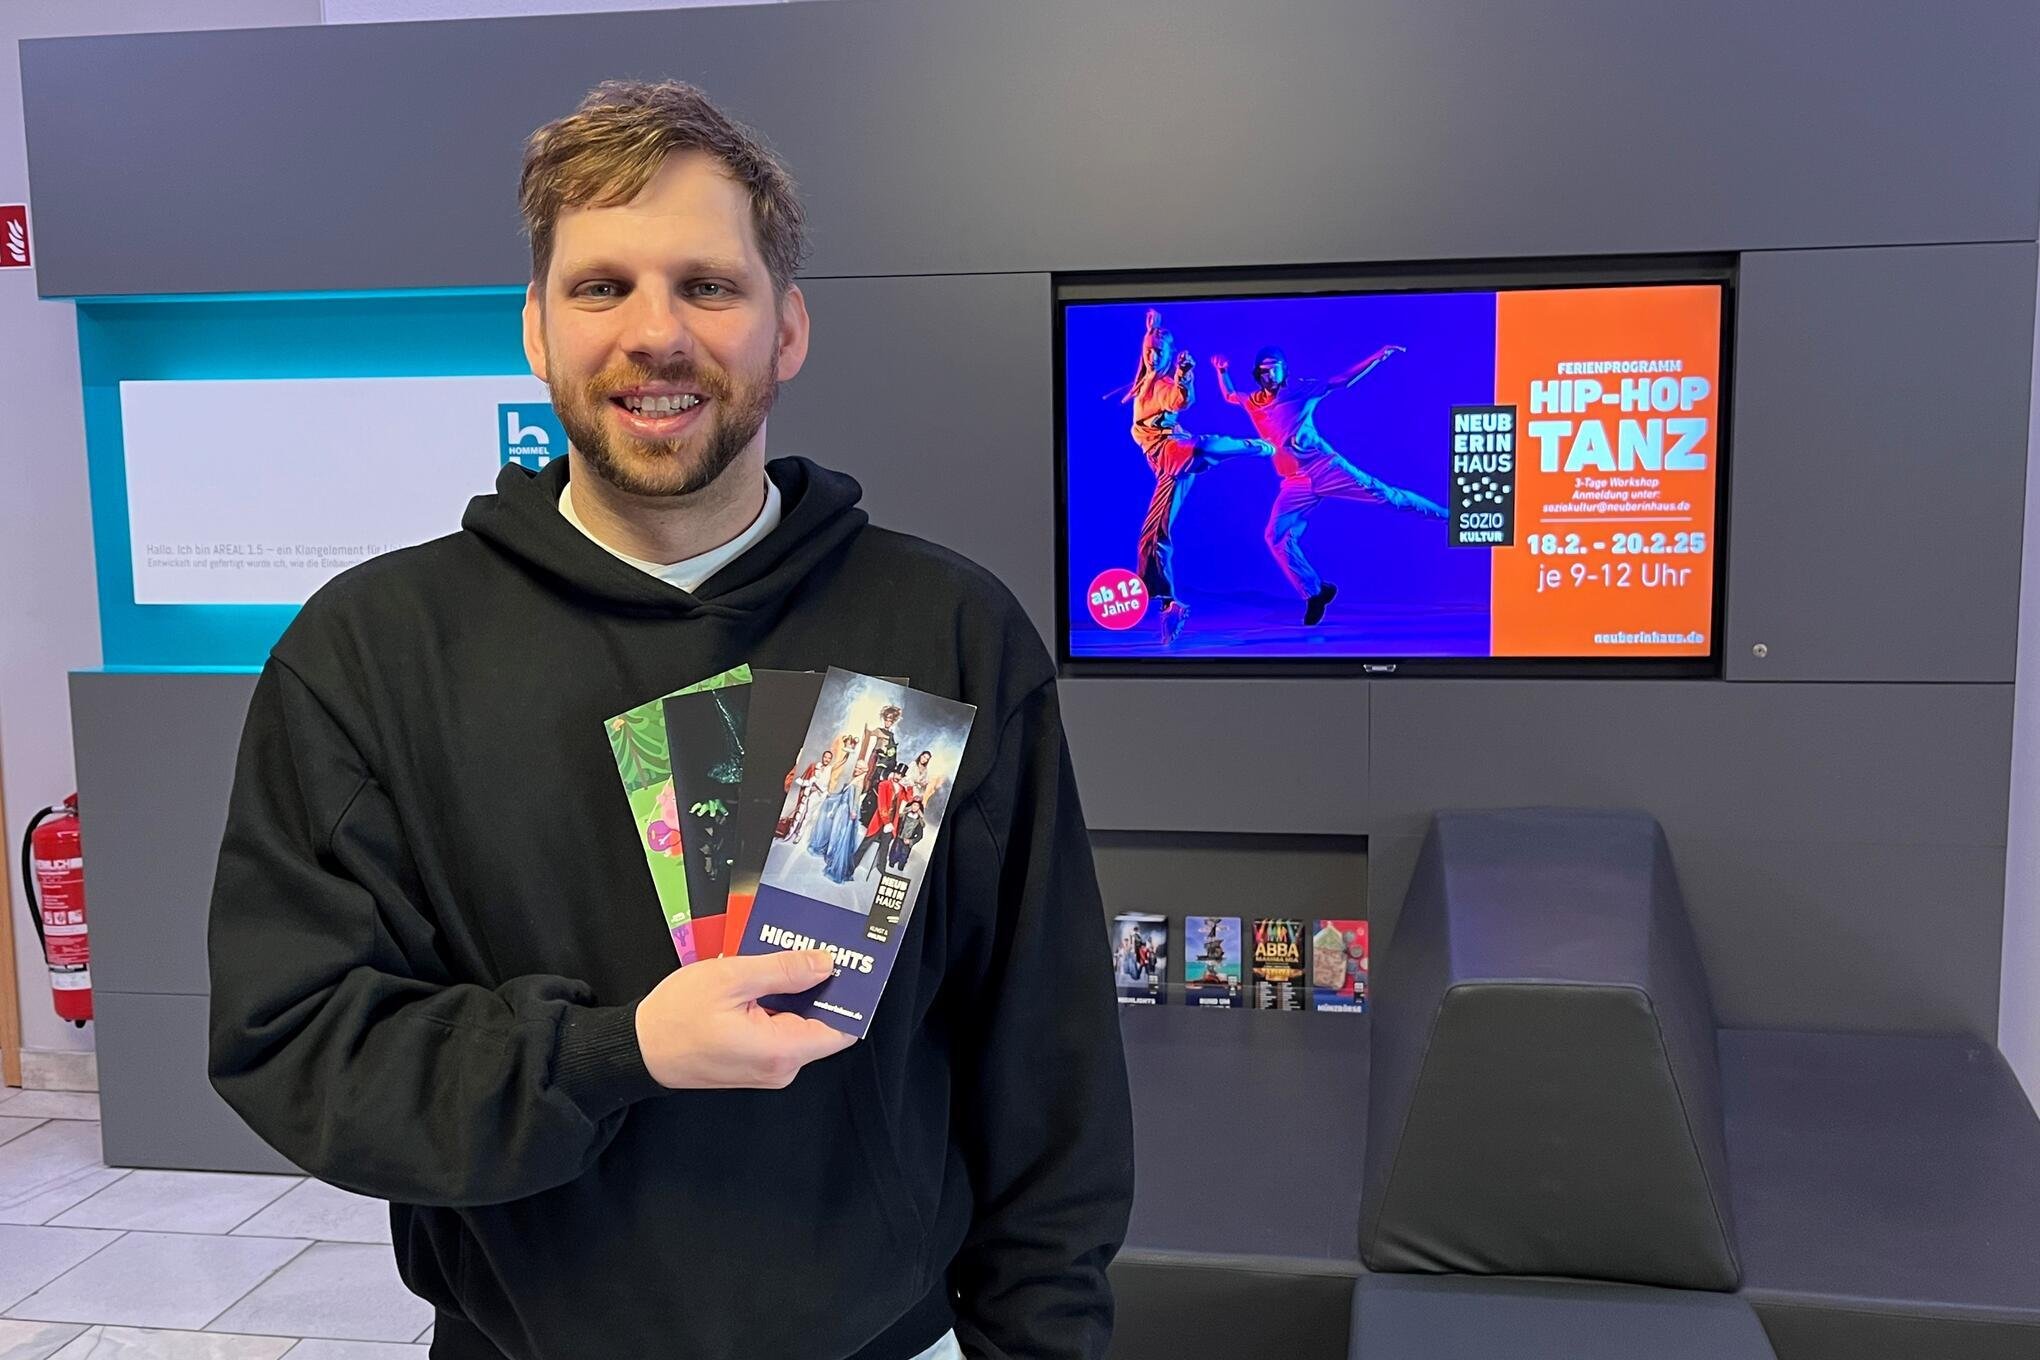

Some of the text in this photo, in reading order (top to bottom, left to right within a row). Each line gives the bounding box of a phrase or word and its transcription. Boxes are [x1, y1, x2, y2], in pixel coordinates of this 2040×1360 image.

[1557, 360, 1683, 375] FERIENPROGRAMM
[1530, 377, 1711, 414] HIP-HOP
[1454, 414, 1513, 433] NEUB
[509, 447, 550, 455] HOMMEL
[1454, 434, 1512, 453] ERIN
[1528, 418, 1707, 473] TANZ
[1454, 454, 1512, 473] HAUS
[1574, 477, 1659, 489] 3-Tage Workshop
[1572, 489, 1660, 501] Anmeldung unter:
[1543, 501, 1691, 513] soziokultur@neuberinhaus.de
[1459, 513, 1503, 529] SOZIO
[1459, 531, 1503, 543] KULTUR
[1527, 534, 1588, 555] 18.2.
[1611, 533, 1706, 554] 20.2.25
[195, 544, 210, 555] bin
[213, 544, 245, 555] AREAL
[1537, 563, 1691, 592] je 9-12 Uhr
[1090, 578, 1143, 606] ab 12
[1101, 599, 1140, 618] Jahre
[1594, 632, 1704, 645] neuberinhaus.de
[881, 876, 909, 892] NEUB
[878, 886, 905, 901] ERIN
[875, 896, 902, 911] HAUS
[1255, 942, 1299, 957] ABBA
